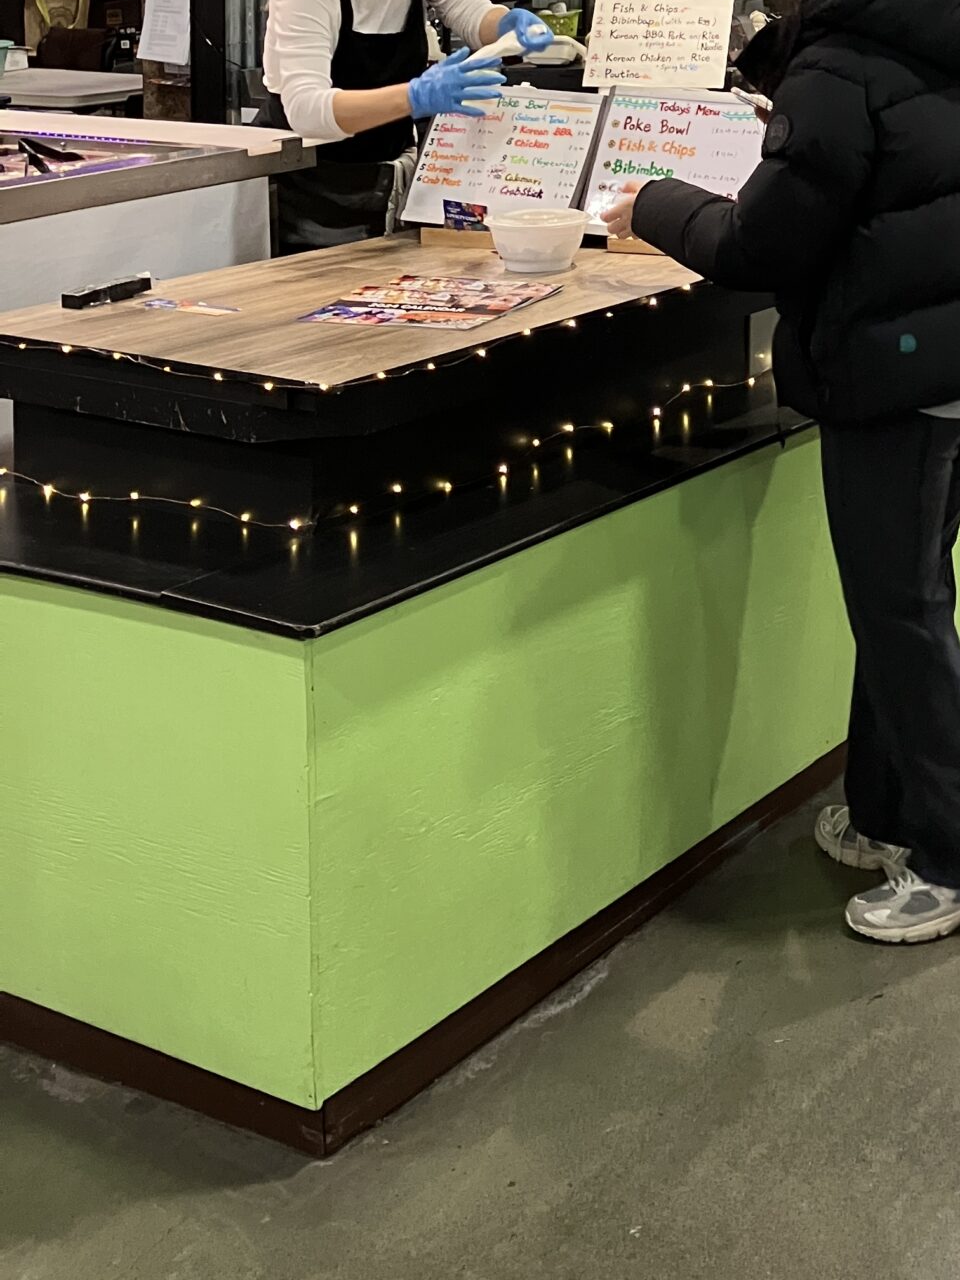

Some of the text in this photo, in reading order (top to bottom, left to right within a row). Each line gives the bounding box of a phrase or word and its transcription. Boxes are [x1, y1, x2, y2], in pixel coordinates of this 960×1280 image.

[613, 3, 634, 13] Fish
[654, 3, 679, 17] Chips
[610, 17, 654, 29] Bibimbap
[610, 29, 638, 40] Korean
[643, 30, 665, 40] BBQ
[668, 31, 686, 40] Pork
[702, 30, 720, 40] Rice
[606, 53, 635, 63] Korean
[640, 53, 671, 63] Chicken
[691, 53, 710, 62] Rice
[605, 70, 640, 79] Poutine
[525, 99, 549, 110] Bowl
[659, 101, 720, 116] Today's Menu
[433, 123, 466, 134] 2 Salmon
[520, 126, 548, 136] Korean
[623, 115, 691, 136] Poke Bowl
[436, 138, 454, 148] Tuna
[514, 138, 549, 149] Chicken
[618, 138, 645, 152] Fish
[647, 141, 657, 152] &
[662, 140, 696, 159] Chips
[431, 150, 469, 162] Dynamite
[500, 154, 507, 162] 9
[420, 163, 453, 175] 5 Shrimp
[612, 159, 674, 178] Bibimbap
[422, 175, 440, 184] Crab
[441, 177, 462, 186] Meat
[401, 304, 465, 312] CALENDAR
